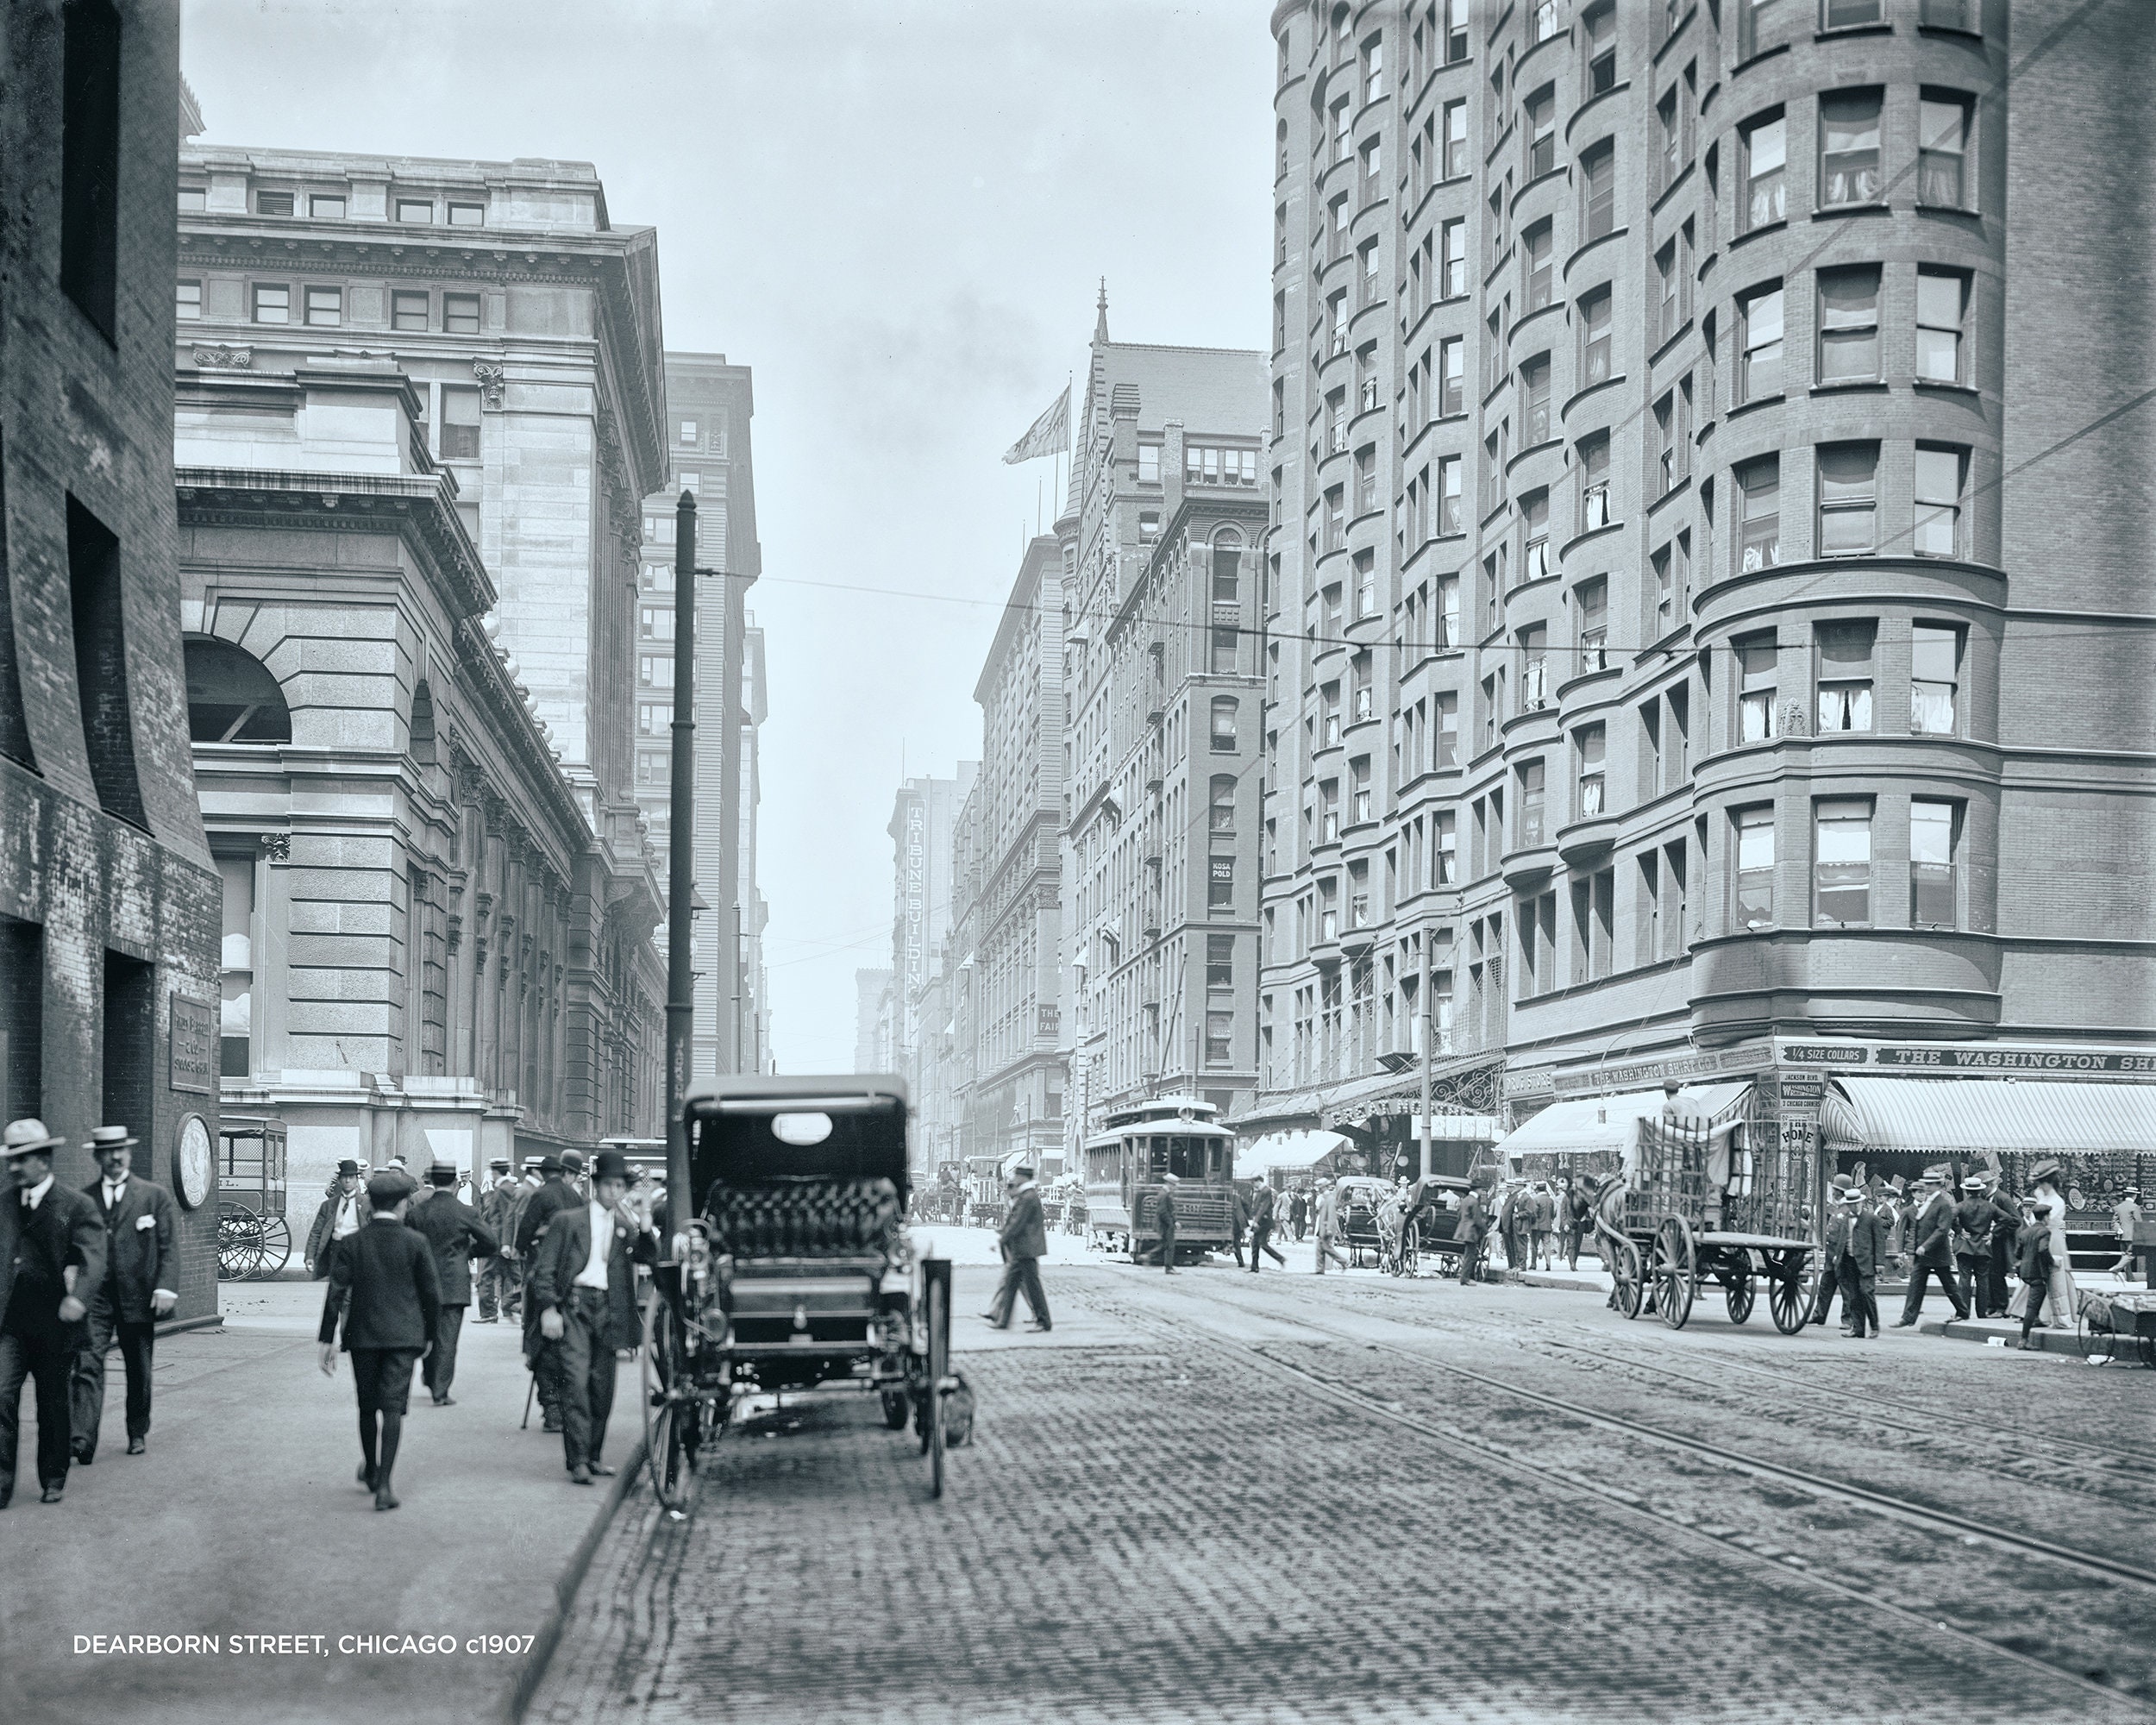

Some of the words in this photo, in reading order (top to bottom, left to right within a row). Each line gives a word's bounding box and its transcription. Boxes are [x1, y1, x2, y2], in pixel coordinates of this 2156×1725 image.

[909, 807, 923, 893] TRIBUNE
[1041, 1009, 1059, 1018] THE
[1807, 1049, 1825, 1060] SIZE
[1827, 1049, 1860, 1061] COLLARS
[1896, 1051, 1941, 1064] THE
[1954, 1051, 2108, 1070] WASHINGTON
[1594, 1071, 1613, 1085] THE
[1613, 1064, 1666, 1083] WASHINGTON
[1667, 1060, 1695, 1076] SHIRT
[1506, 1076, 1525, 1093] DRUG
[1783, 1084, 1821, 1096] WASHINGTON
[1330, 1100, 1391, 1126] GREAT
[1782, 1129, 1814, 1143] HOME
